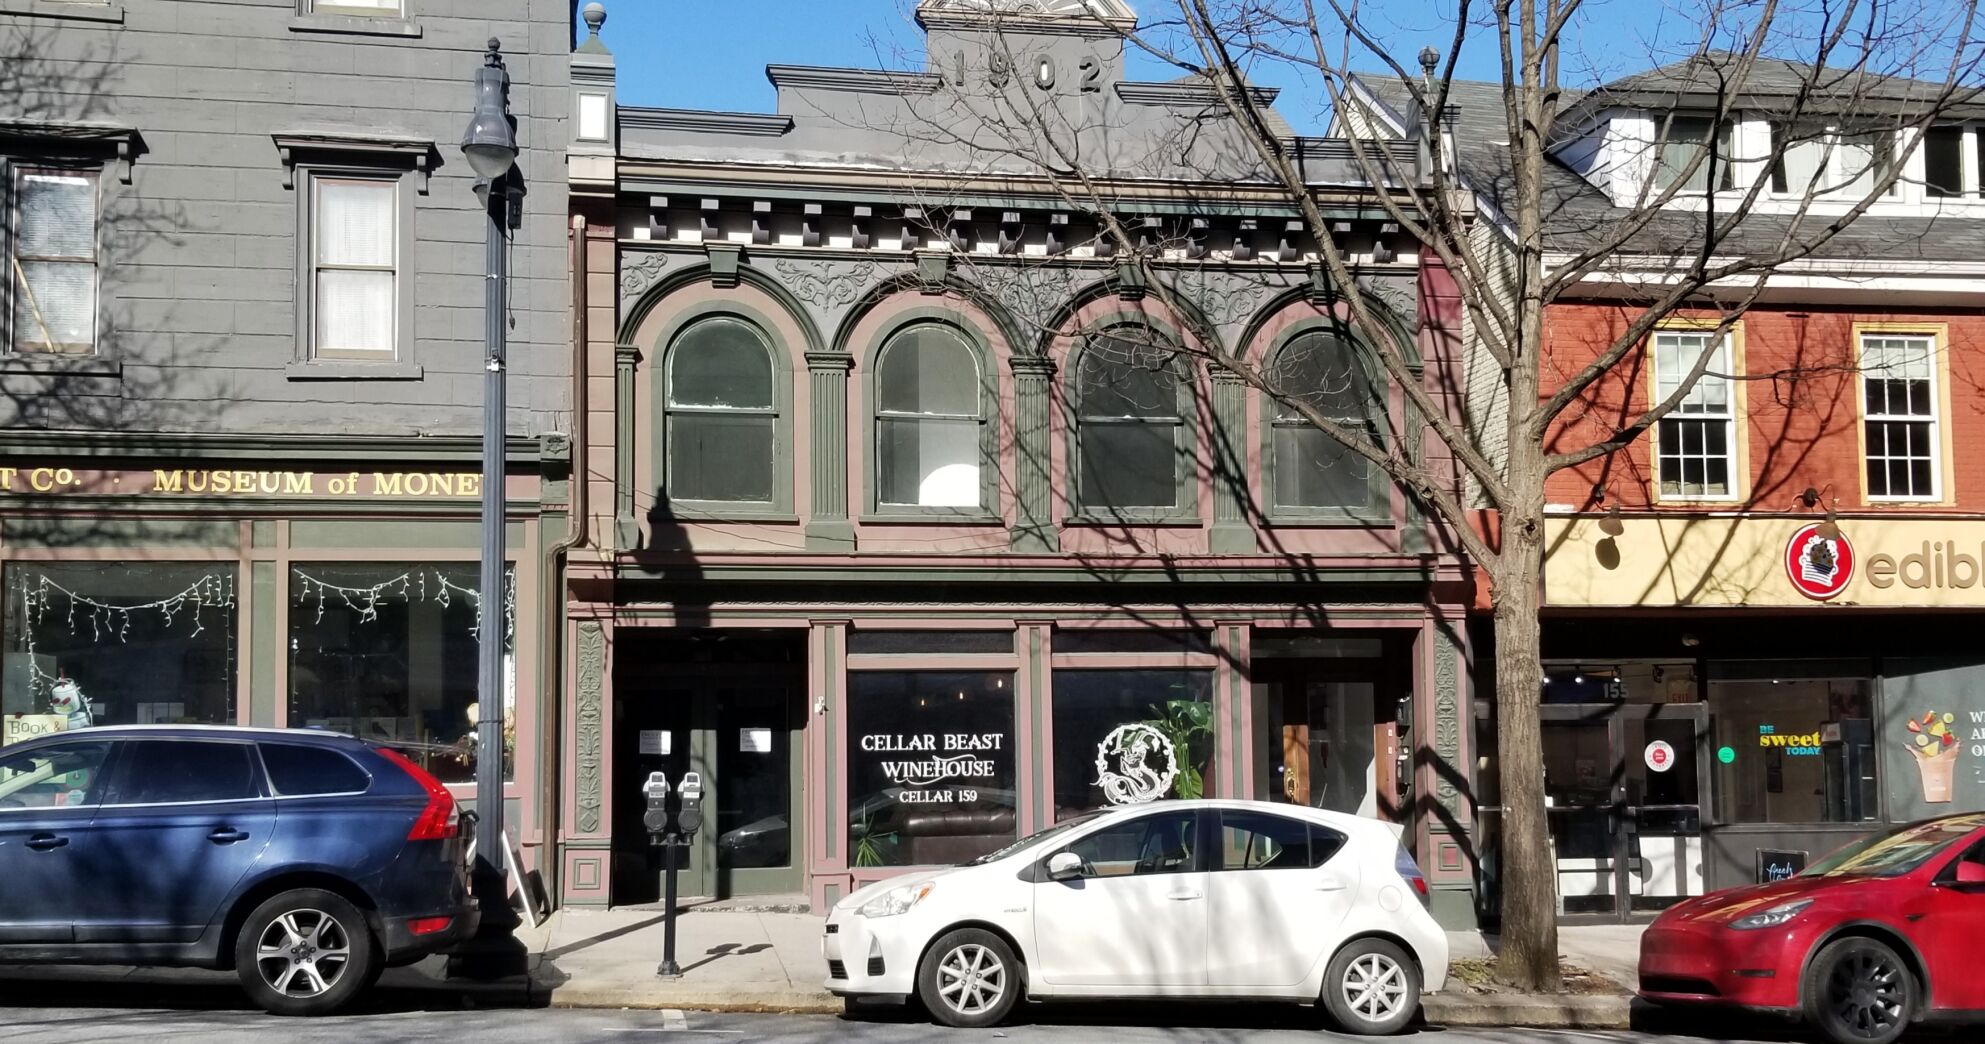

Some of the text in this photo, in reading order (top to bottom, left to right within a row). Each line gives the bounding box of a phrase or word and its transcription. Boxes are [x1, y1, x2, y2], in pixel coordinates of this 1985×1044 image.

[953, 49, 1101, 93] 1902
[153, 470, 314, 493] MUSEUM
[328, 472, 360, 494] of
[373, 472, 484, 496] MONE
[1603, 683, 1630, 699] 155
[1969, 711, 1985, 723] W
[1760, 725, 1774, 734] BE
[861, 733, 1004, 751] CELLAR BEAST
[1760, 731, 1821, 747] sweet
[1785, 747, 1821, 756] TODAY
[881, 755, 995, 784] WINEHOUSE
[900, 789, 978, 803] CELLAR 159
